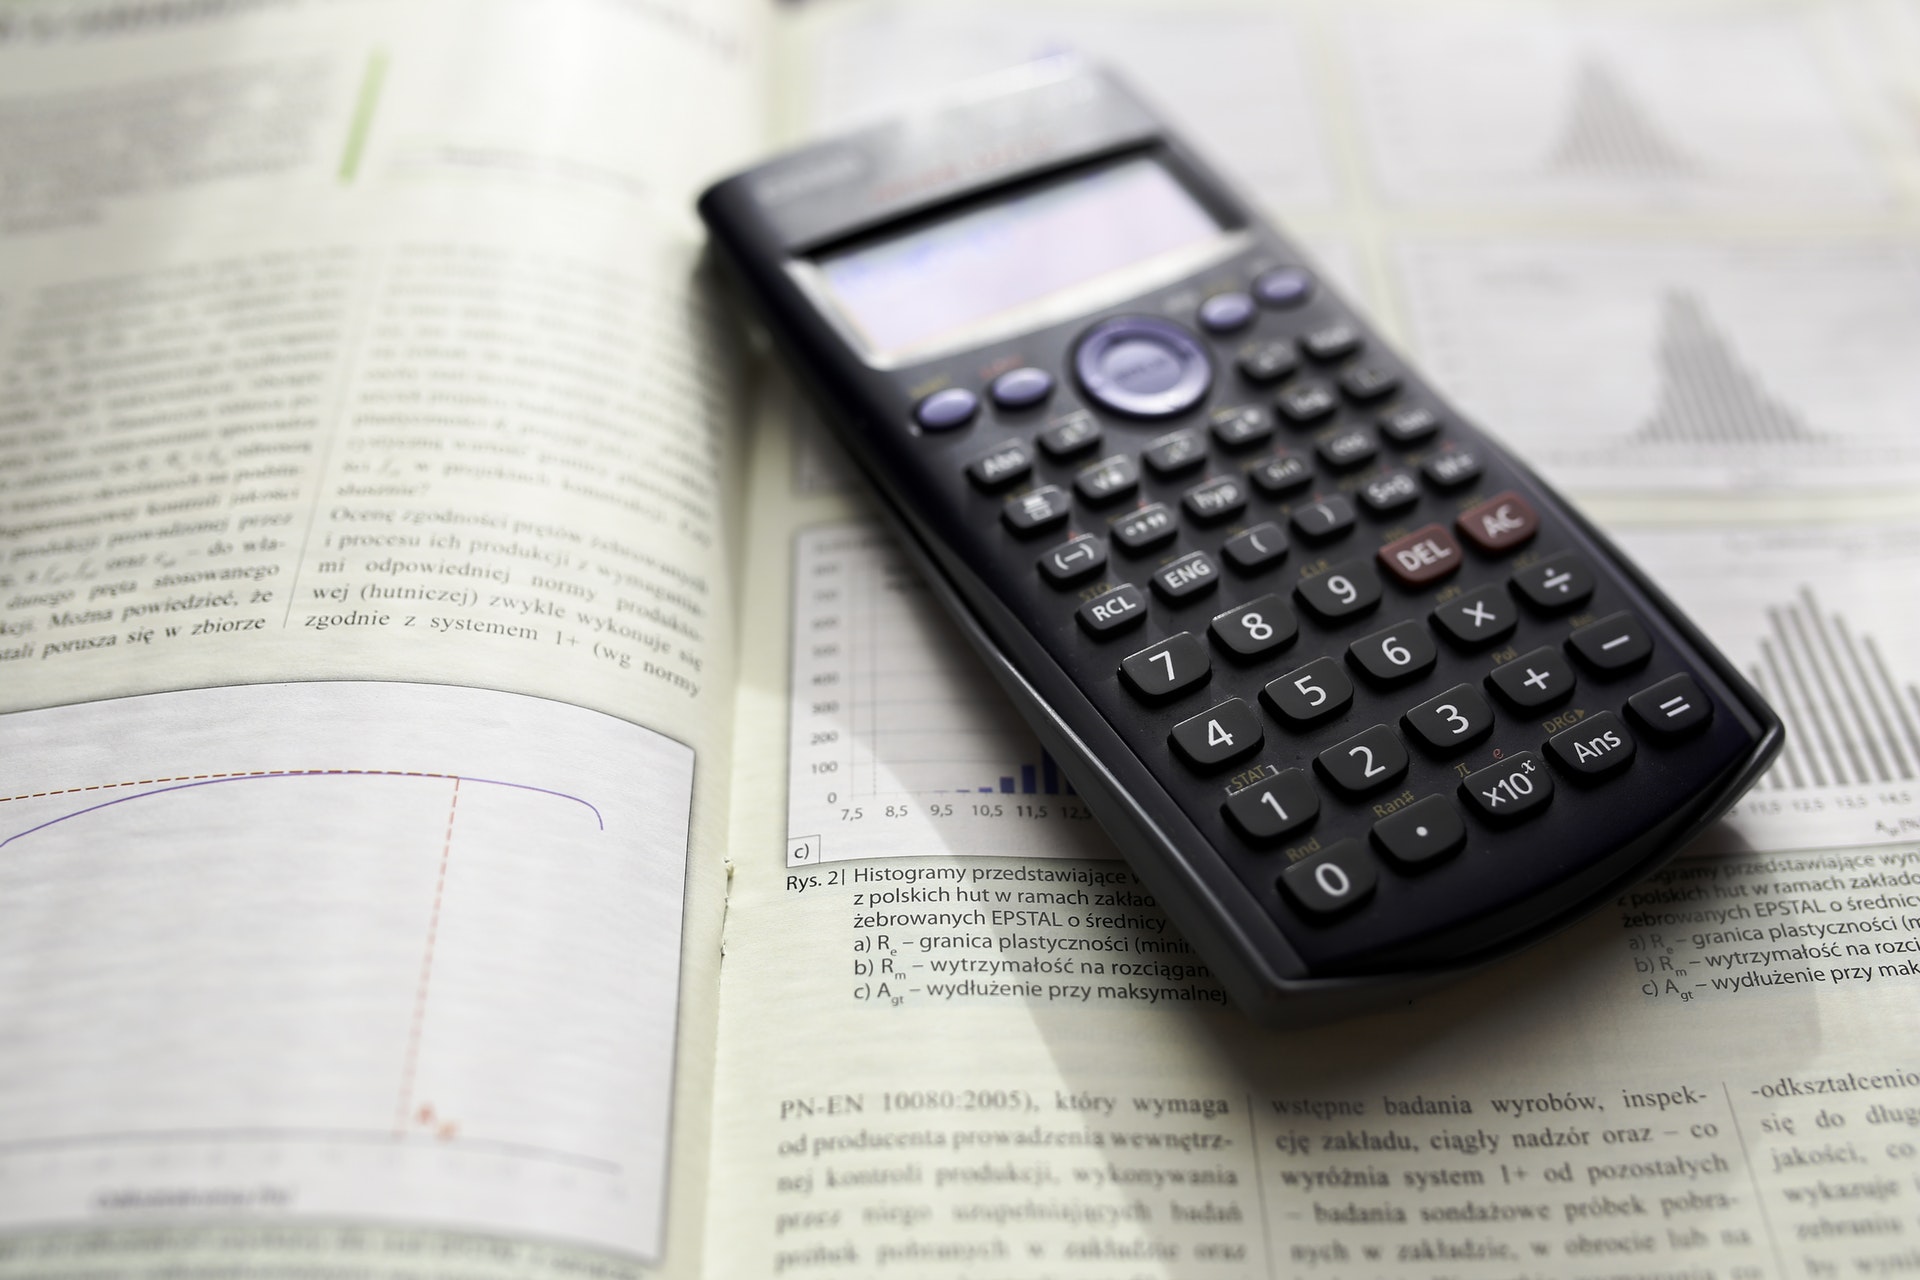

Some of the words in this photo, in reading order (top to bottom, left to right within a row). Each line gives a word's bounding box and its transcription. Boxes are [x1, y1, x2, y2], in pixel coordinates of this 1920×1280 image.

[1482, 504, 1524, 538] AC
[338, 534, 421, 552] procesu
[430, 533, 461, 549] ich
[1397, 539, 1451, 572] DEL
[154, 565, 280, 589] stosowanego
[318, 557, 346, 573] mi
[365, 557, 510, 584] odpowiedniej
[532, 576, 596, 603] normy
[1164, 559, 1210, 588] ENG
[1327, 575, 1357, 605] 9
[122, 590, 238, 622] powiedzieć,
[250, 590, 273, 604] że
[313, 583, 349, 603] wej
[360, 583, 478, 607] (hutniczej)
[490, 596, 566, 618] zwykle
[577, 611, 671, 653] wykonuje
[1092, 596, 1137, 622] RCL
[42, 635, 117, 660] porusza
[127, 626, 154, 644] się
[165, 626, 181, 638] w
[191, 617, 266, 636] zbiorze
[1241, 612, 1273, 641] 8
[305, 610, 390, 631] zgodnie
[404, 615, 416, 627] z
[430, 615, 538, 641] systemem
[556, 630, 579, 646] 1+
[593, 642, 631, 669] (wg
[643, 661, 701, 698] normy
[1382, 636, 1411, 665] 6
[1148, 650, 1176, 681] 7
[1294, 675, 1327, 707] 5
[1208, 718, 1234, 747] 4
[1435, 704, 1469, 734] 3
[811, 730, 838, 745] 200
[1573, 730, 1621, 764] Ans
[811, 760, 838, 775] 100
[1349, 746, 1386, 778] 2
[827, 794, 837, 804] 0
[841, 807, 863, 821] 7,5
[885, 804, 908, 819] 8,5
[930, 804, 953, 818] 9,5
[972, 804, 1003, 818] 10,5
[1017, 804, 1048, 820] 11,5
[1261, 791, 1288, 820] 1
[1372, 790, 1415, 818] Ran#
[794, 843, 810, 859] c)
[1286, 837, 1320, 862] Rnd
[854, 867, 966, 884] Histogramy
[973, 865, 1127, 887] przedstawiające
[1315, 863, 1349, 897] 0
[1724, 855, 1873, 880] przedstawiające
[786, 875, 822, 893] Rys.
[853, 894, 864, 906] z
[869, 887, 950, 908] polskich
[957, 886, 990, 903] hut
[994, 891, 1012, 903] w
[1018, 890, 1089, 906] ramach
[1714, 883, 1748, 900] hut
[1751, 884, 1768, 896] w
[1774, 875, 1845, 895] ramach
[853, 909, 986, 929] żebrowanych
[992, 910, 1063, 927] EPSTAL
[1068, 916, 1080, 927] o
[1086, 912, 1167, 933] średnicy
[1622, 904, 1751, 930] żebrowanych
[1755, 899, 1826, 918] EPSTAL
[1830, 901, 1842, 913] o
[854, 936, 871, 953] a)
[920, 933, 992, 953] granica
[999, 933, 1129, 954] plastyczności
[1629, 934, 1646, 951] a)
[1692, 926, 1764, 949] granica
[1769, 916, 1898, 942] plastyczności
[854, 959, 873, 977] b)
[930, 957, 1074, 976] wytrzymałość
[1081, 962, 1104, 975] na
[1112, 960, 1215, 981] rozciągan
[1634, 956, 1655, 975] b)
[1705, 943, 1842, 970] wytrzymałość
[1846, 943, 1871, 957] na
[854, 983, 870, 1001] c)
[927, 980, 1042, 1000] wydłużenie
[1049, 985, 1092, 1002] przy
[1098, 982, 1227, 1006] maksymalnej
[1642, 980, 1659, 997] c)
[1711, 970, 1825, 993] wydłużenie
[1830, 964, 1872, 984] przy
[780, 1093, 863, 1120] PN-EN
[884, 1089, 1040, 1112] 10080:2005),
[1056, 1090, 1116, 1117] który
[1132, 1098, 1230, 1120] wymaga
[1270, 1098, 1364, 1121] wstępne
[1383, 1094, 1472, 1115] badania
[1490, 1092, 1604, 1118] wyrobów,
[1621, 1086, 1707, 1110] inspek-
[1760, 1112, 1796, 1136] się
[1815, 1109, 1845, 1129] do
[1866, 1104, 1920, 1127] dług
[778, 1133, 807, 1155] od
[813, 1129, 946, 1157] producenta
[953, 1126, 1104, 1152] prowadzenia
[1111, 1131, 1232, 1152] wewnętrz-
[1275, 1129, 1310, 1156] cję
[1322, 1130, 1419, 1152] zakładu,
[1429, 1129, 1499, 1155] ciągły
[1512, 1126, 1590, 1149] nadzór
[1602, 1128, 1654, 1144] oraz
[1690, 1123, 1719, 1139] co
[1886, 1142, 1915, 1159] co
[1281, 1165, 1390, 1193] wyróżnia
[1403, 1168, 1485, 1193] system
[1543, 1161, 1573, 1182] od
[1587, 1153, 1729, 1186] pozostałych
